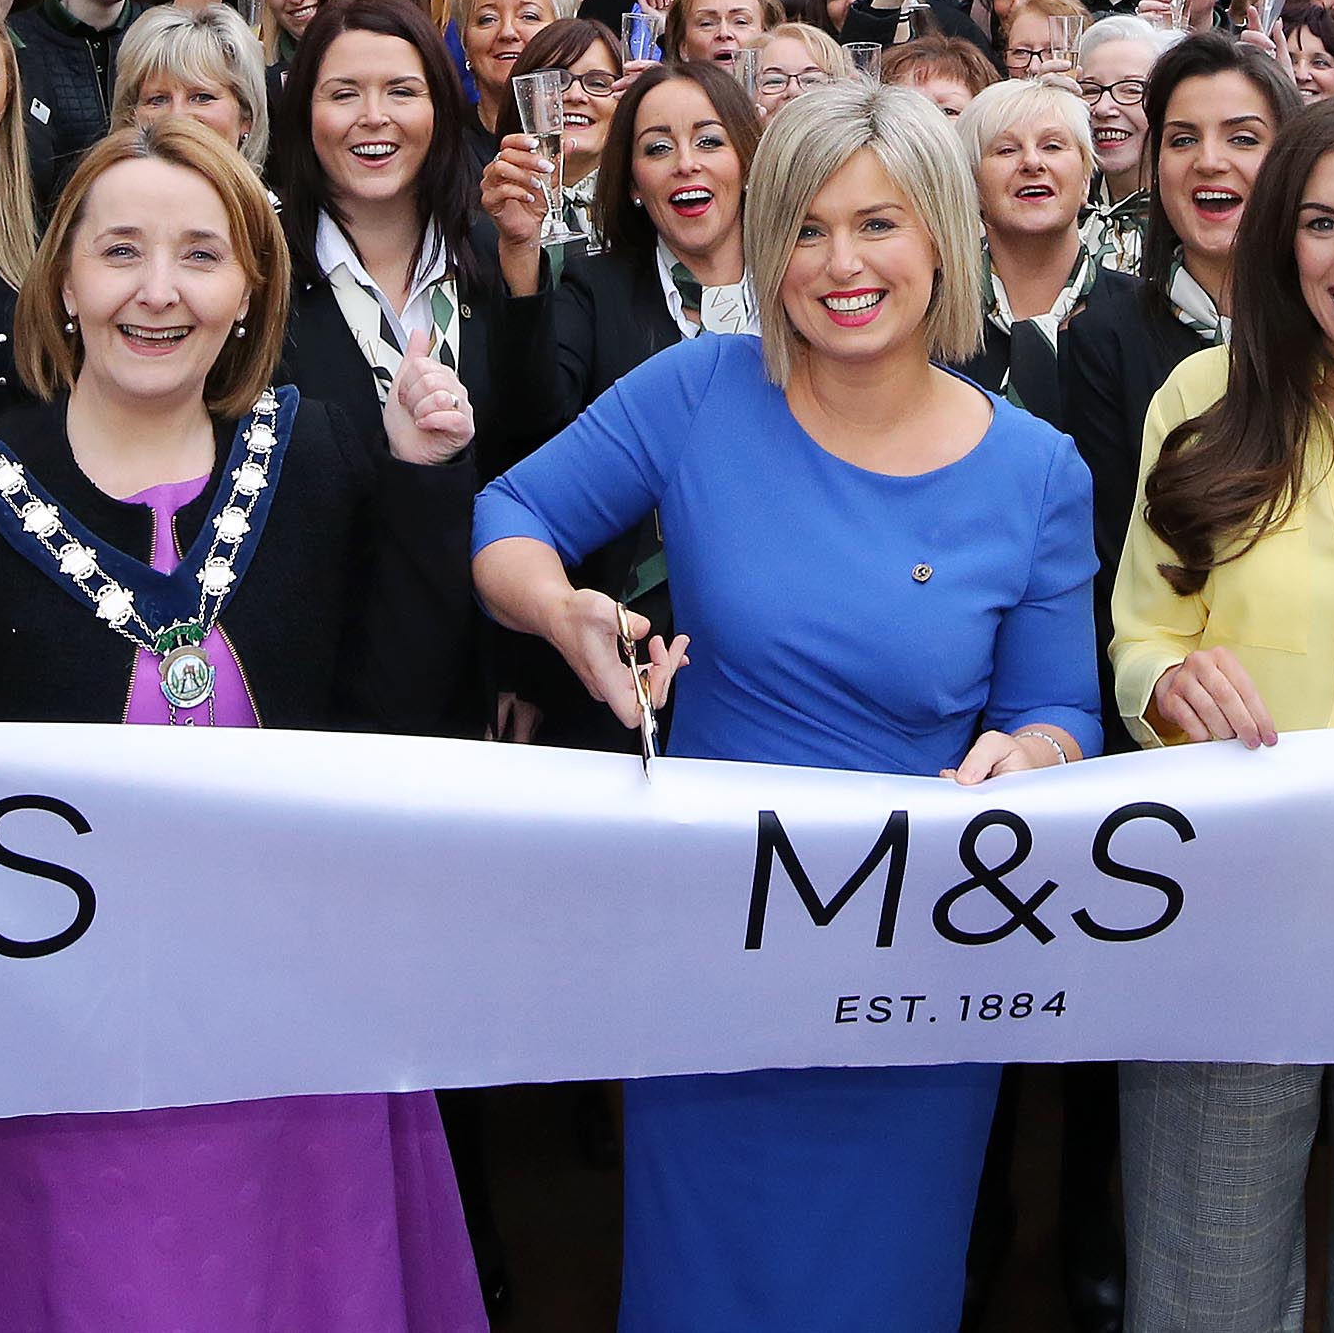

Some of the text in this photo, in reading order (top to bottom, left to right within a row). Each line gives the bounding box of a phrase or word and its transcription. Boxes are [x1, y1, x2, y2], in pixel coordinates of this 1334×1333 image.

[744, 802, 1197, 950] M&S
[835, 990, 1068, 1024] EST. 1884
